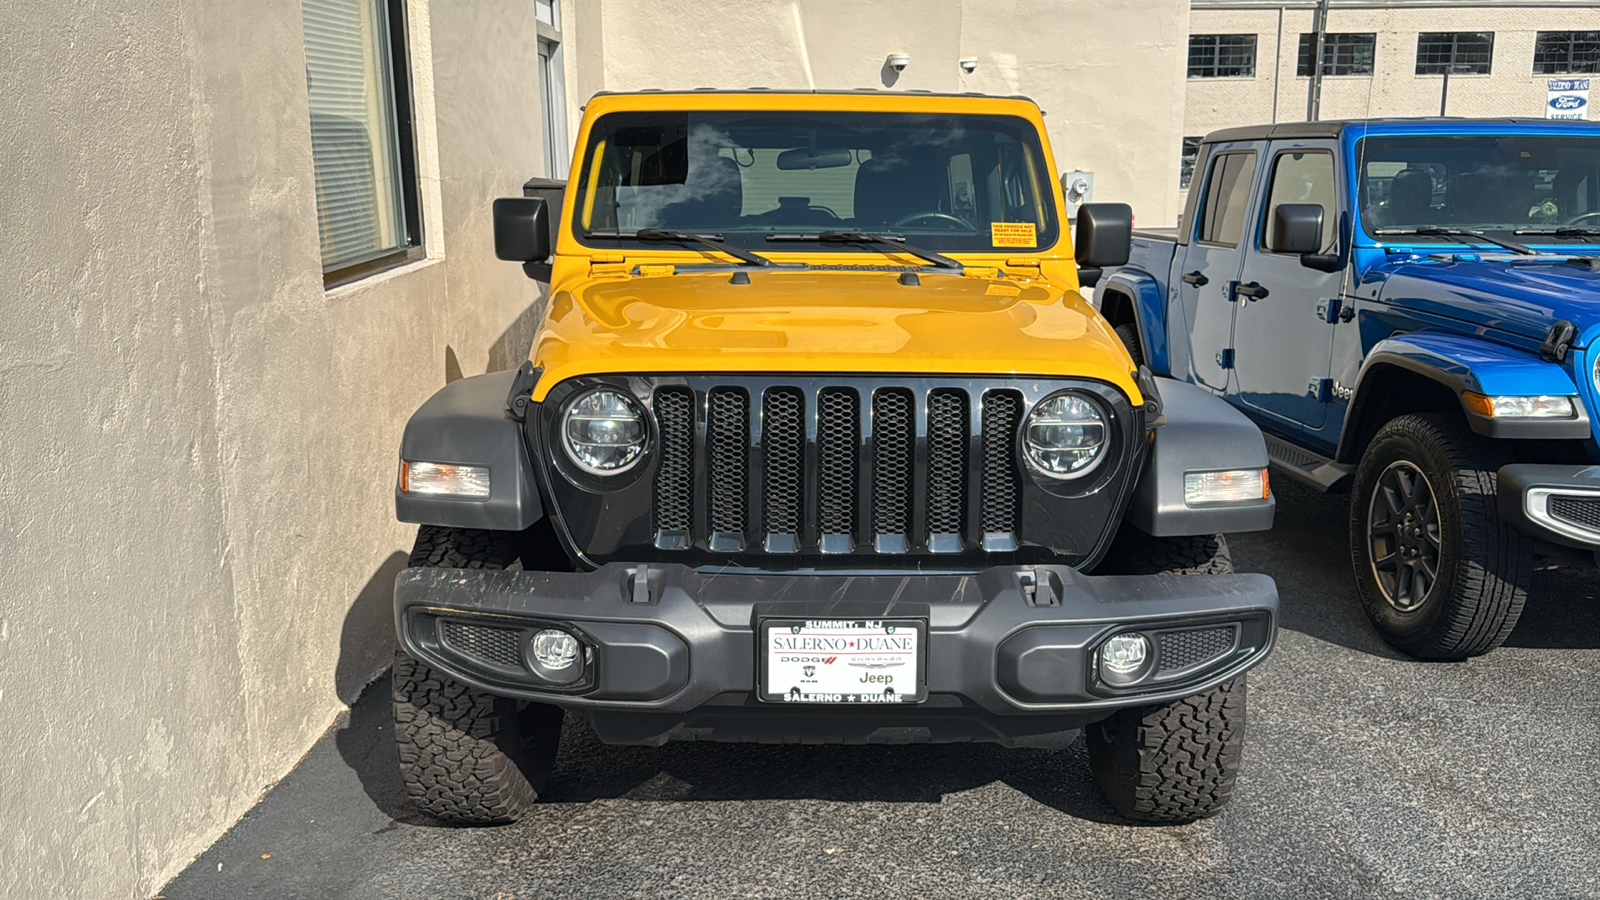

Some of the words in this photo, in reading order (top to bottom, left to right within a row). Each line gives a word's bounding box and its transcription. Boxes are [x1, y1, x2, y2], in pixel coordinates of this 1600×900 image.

[1555, 97, 1580, 108] Ford
[1331, 381, 1353, 400] Jee
[865, 620, 883, 629] NJ
[774, 637, 847, 650] SALERNO
[856, 637, 913, 650] DUANE
[859, 672, 893, 685] Jeep
[783, 693, 842, 702] SALERNO
[861, 693, 902, 702] DUANE
